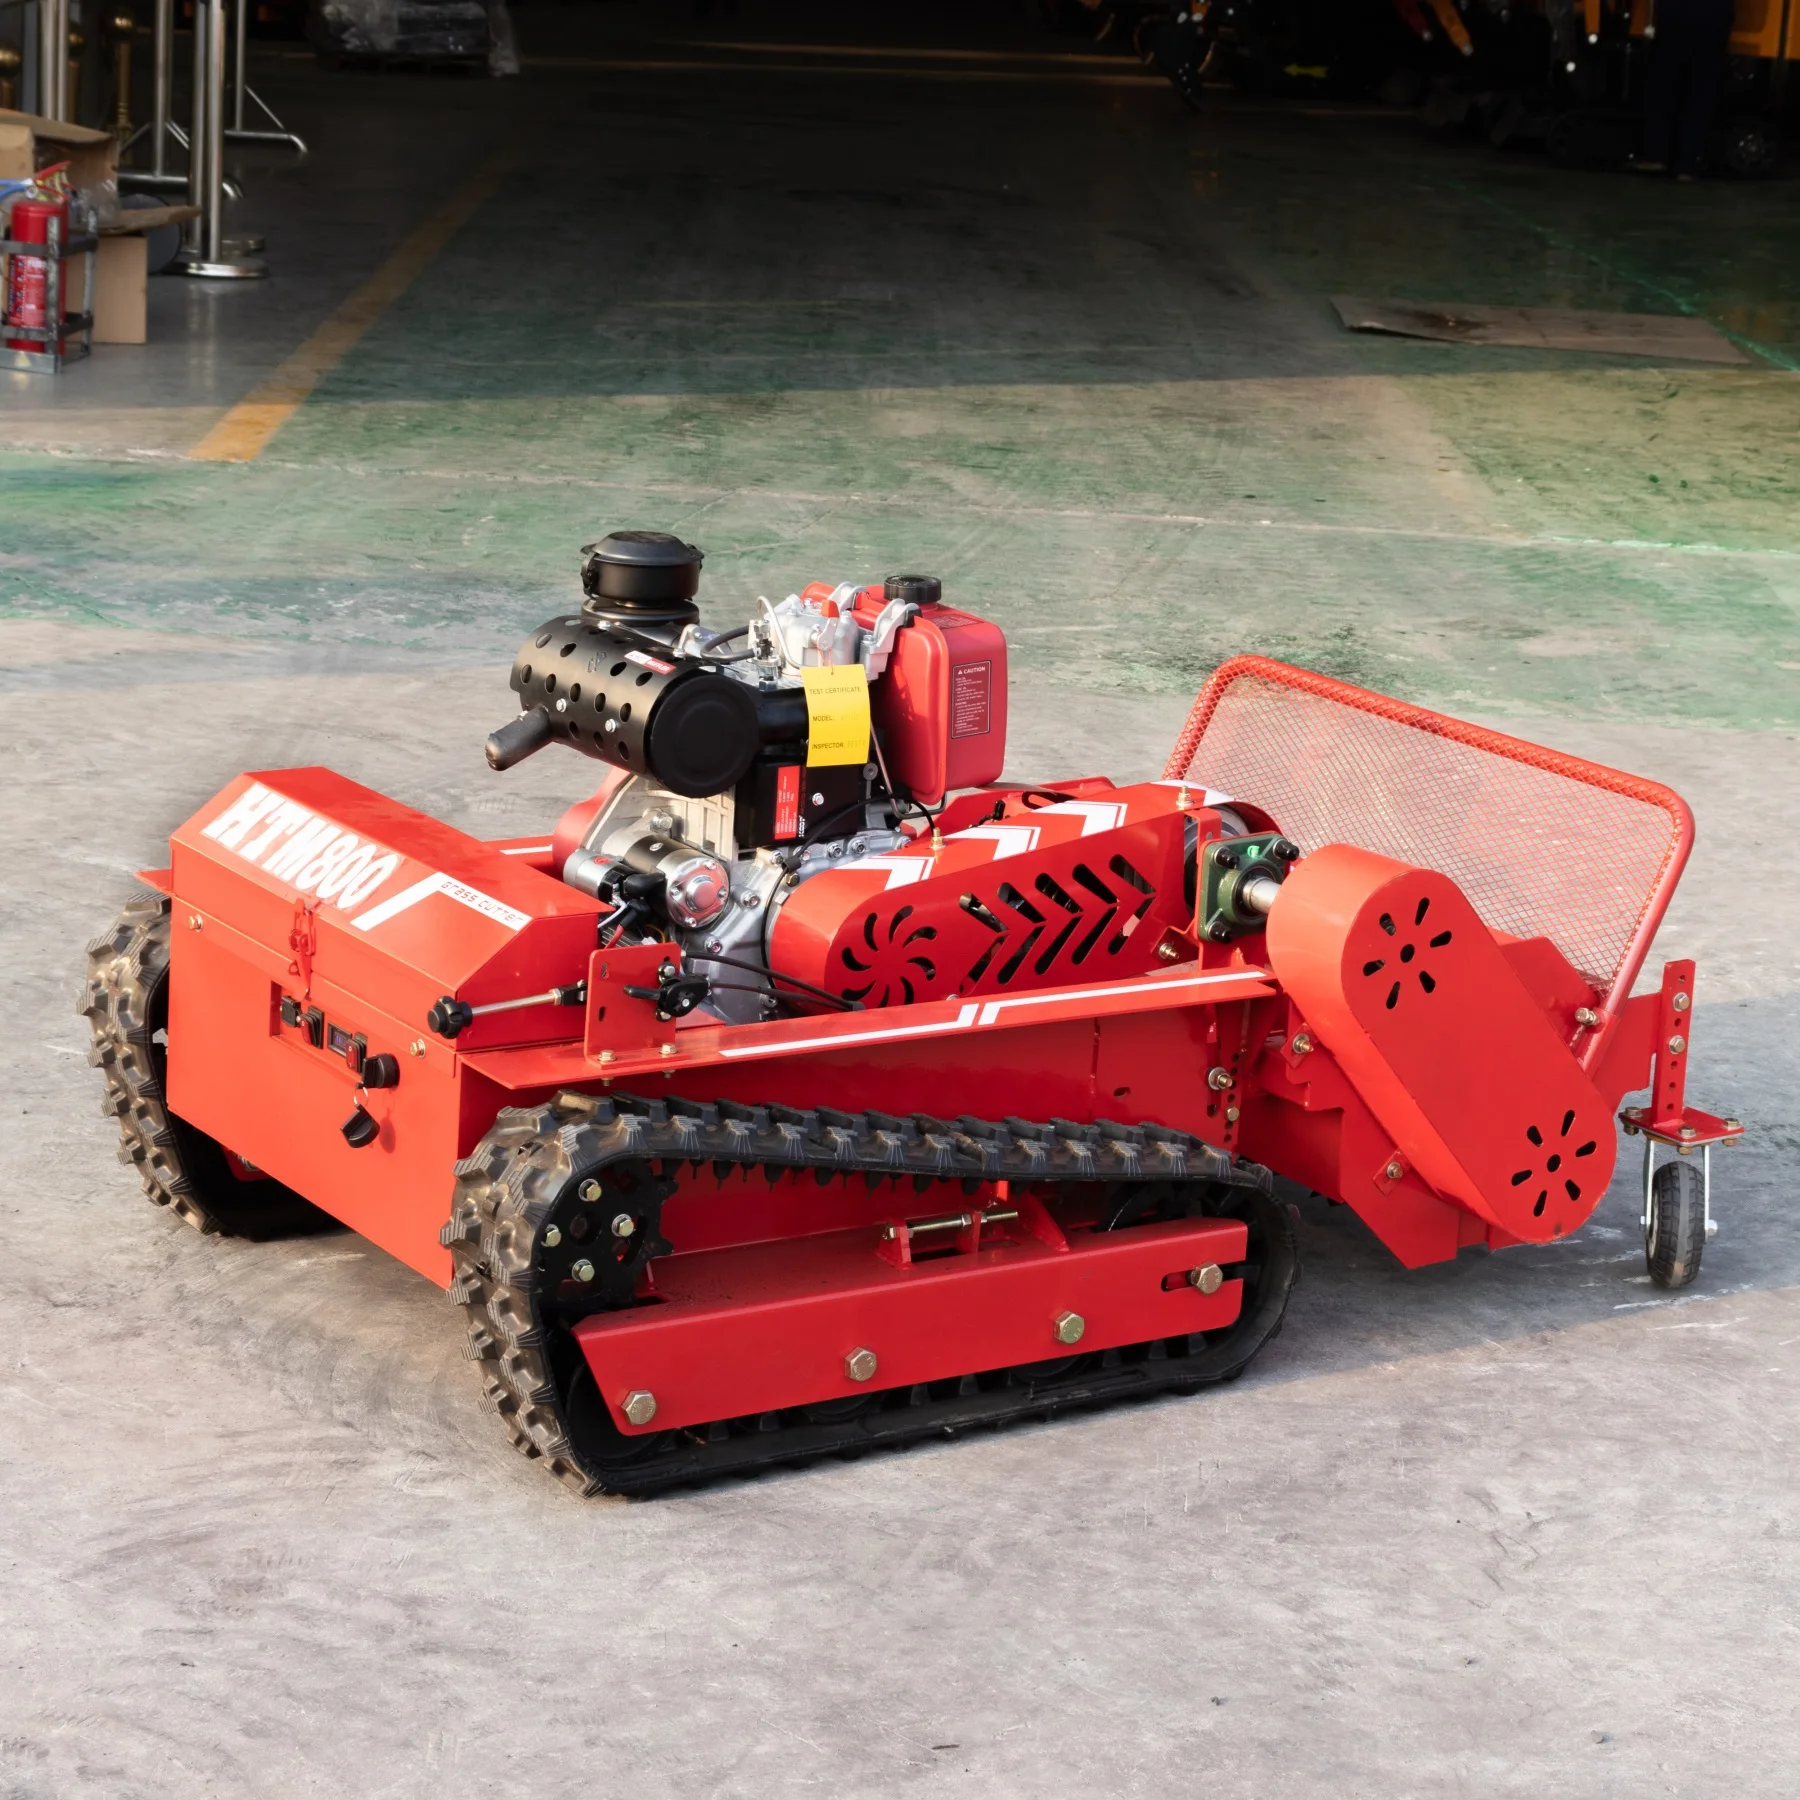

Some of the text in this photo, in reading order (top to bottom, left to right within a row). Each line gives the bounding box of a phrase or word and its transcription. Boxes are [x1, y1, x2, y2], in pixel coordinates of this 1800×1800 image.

[963, 666, 986, 674] CAUTION
[825, 686, 861, 694] CERTIFICATE
[200, 782, 399, 909] HTM800
